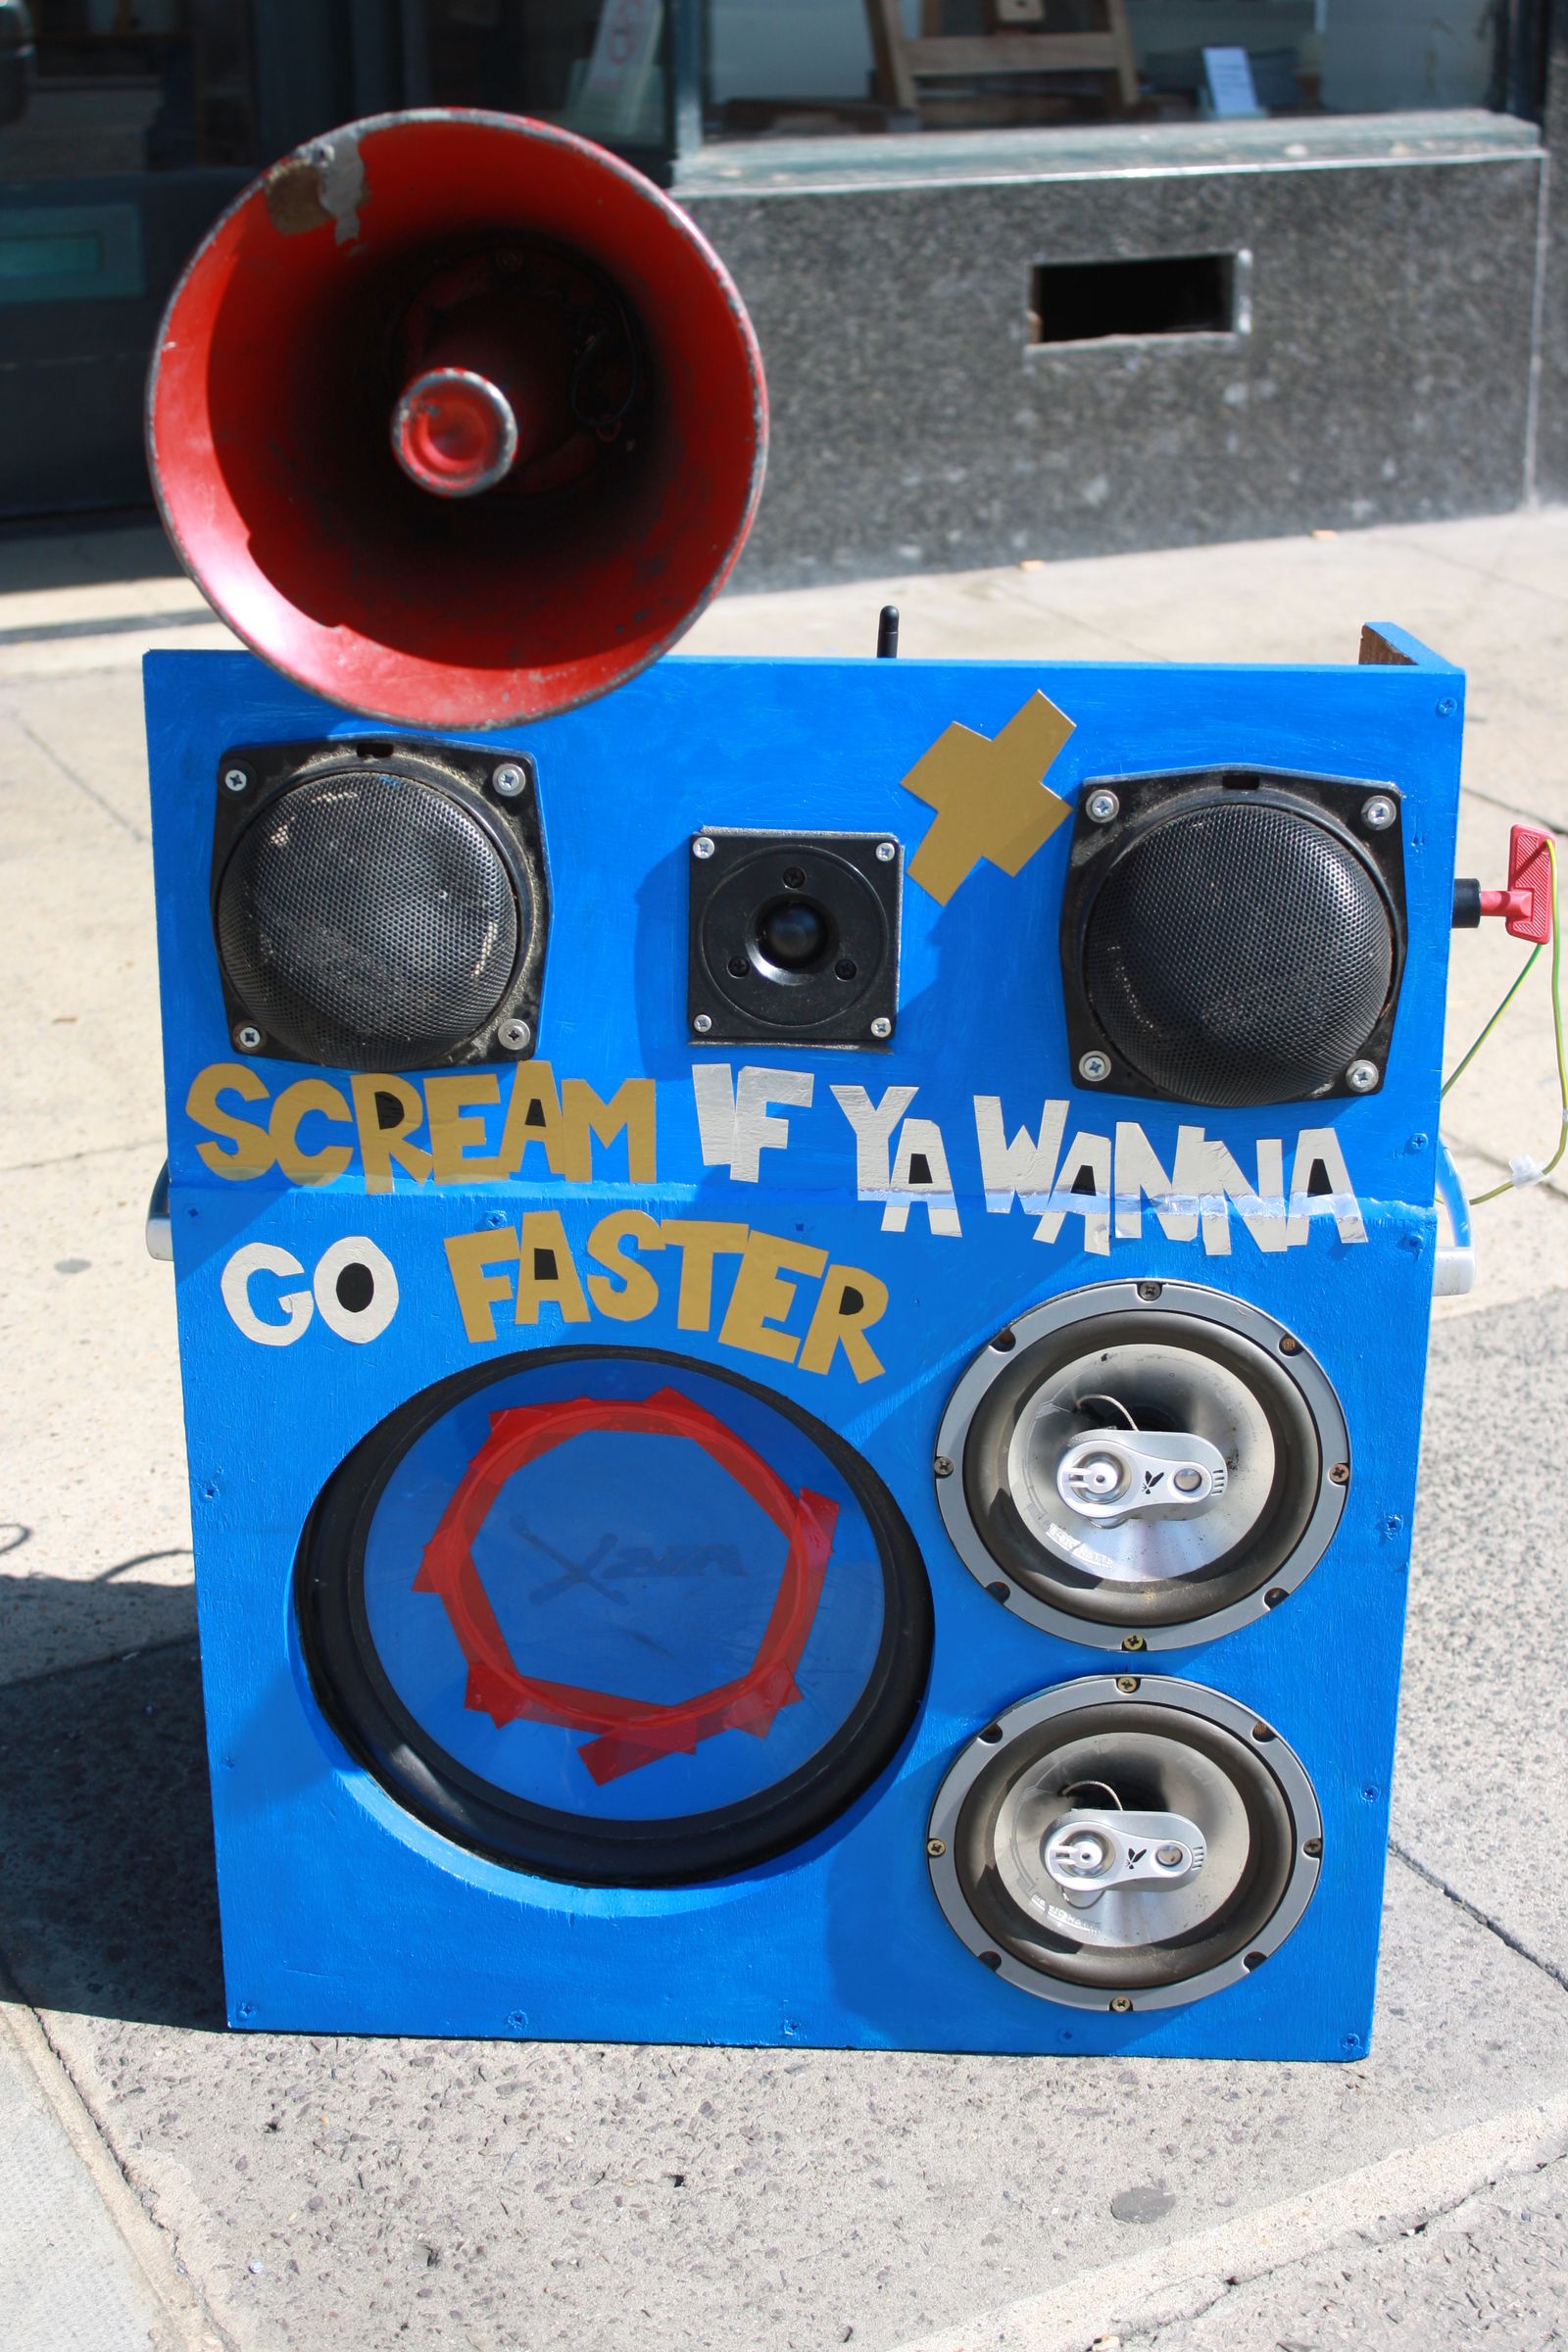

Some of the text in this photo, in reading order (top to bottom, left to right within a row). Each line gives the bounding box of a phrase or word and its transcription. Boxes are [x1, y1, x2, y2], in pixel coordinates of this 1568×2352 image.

[185, 1059, 1369, 1256] SCREAM IF YA WANNA
[220, 1209, 890, 1385] GO FASTER
